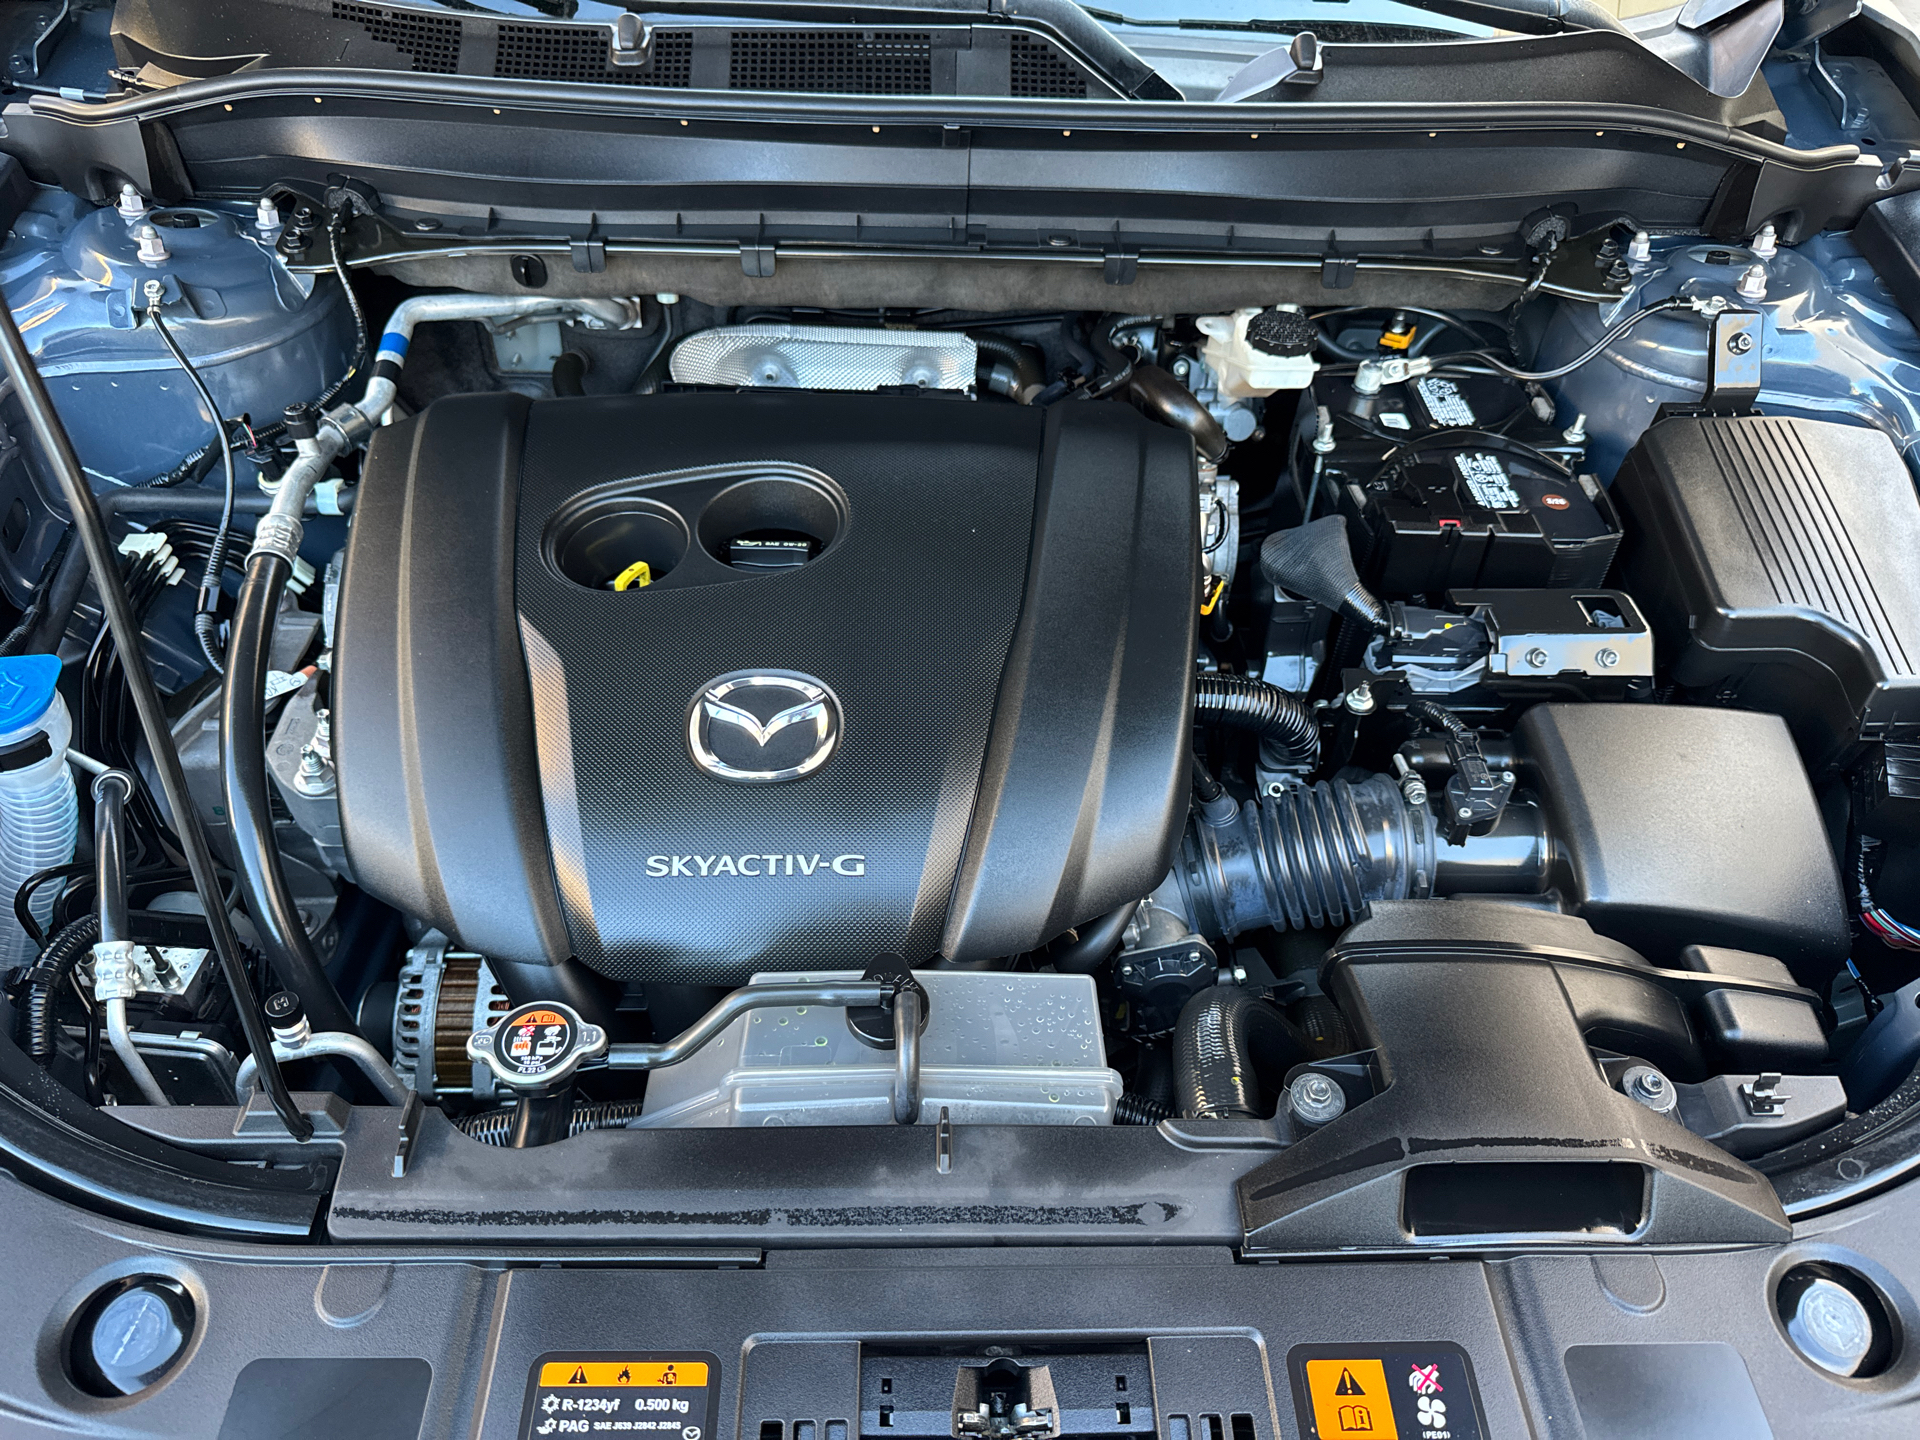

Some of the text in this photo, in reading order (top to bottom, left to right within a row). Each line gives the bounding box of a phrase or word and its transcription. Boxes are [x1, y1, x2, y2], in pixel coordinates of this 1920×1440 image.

[645, 854, 865, 877] SKYACTIV-G
[562, 1399, 689, 1414] R-1234yf 0.500 kg
[558, 1420, 589, 1433] PAG
[593, 1422, 613, 1430] SAE
[1422, 1431, 1451, 1439] (PE01)
